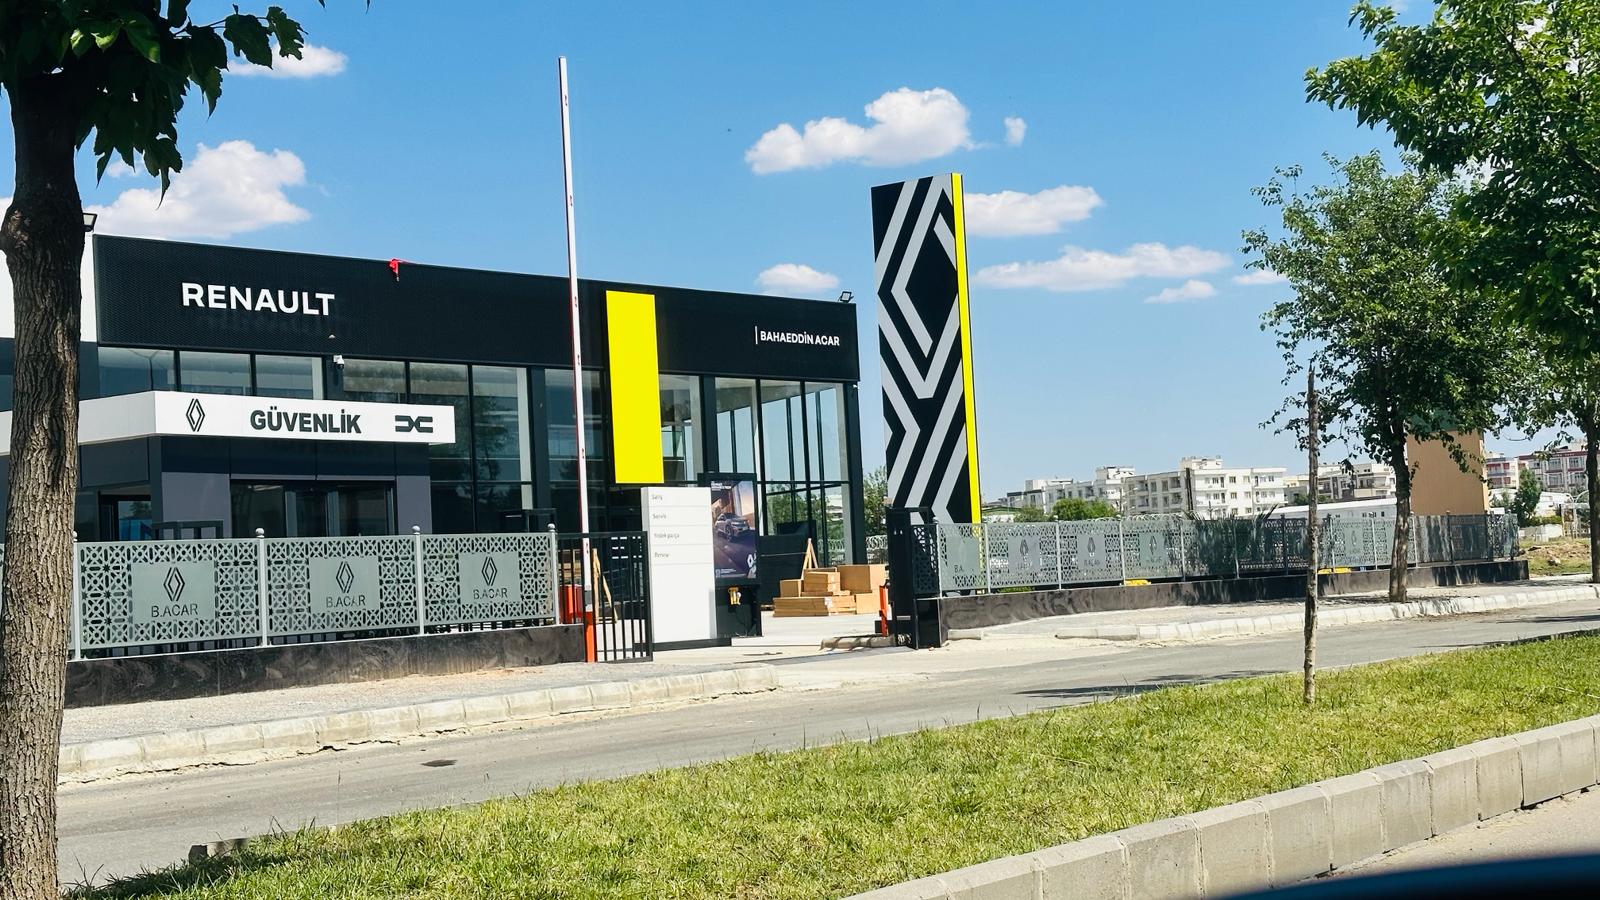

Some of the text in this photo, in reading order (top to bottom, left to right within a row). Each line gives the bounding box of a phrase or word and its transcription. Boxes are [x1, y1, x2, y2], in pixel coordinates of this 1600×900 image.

[181, 282, 335, 316] RENAULT
[760, 330, 840, 346] BAHAEDDİN ACAR
[250, 406, 362, 434] GÜVENLİK
[325, 594, 366, 608] B.ACAR
[473, 587, 508, 600] B.ACAR
[151, 603, 199, 618] B.ACAR
